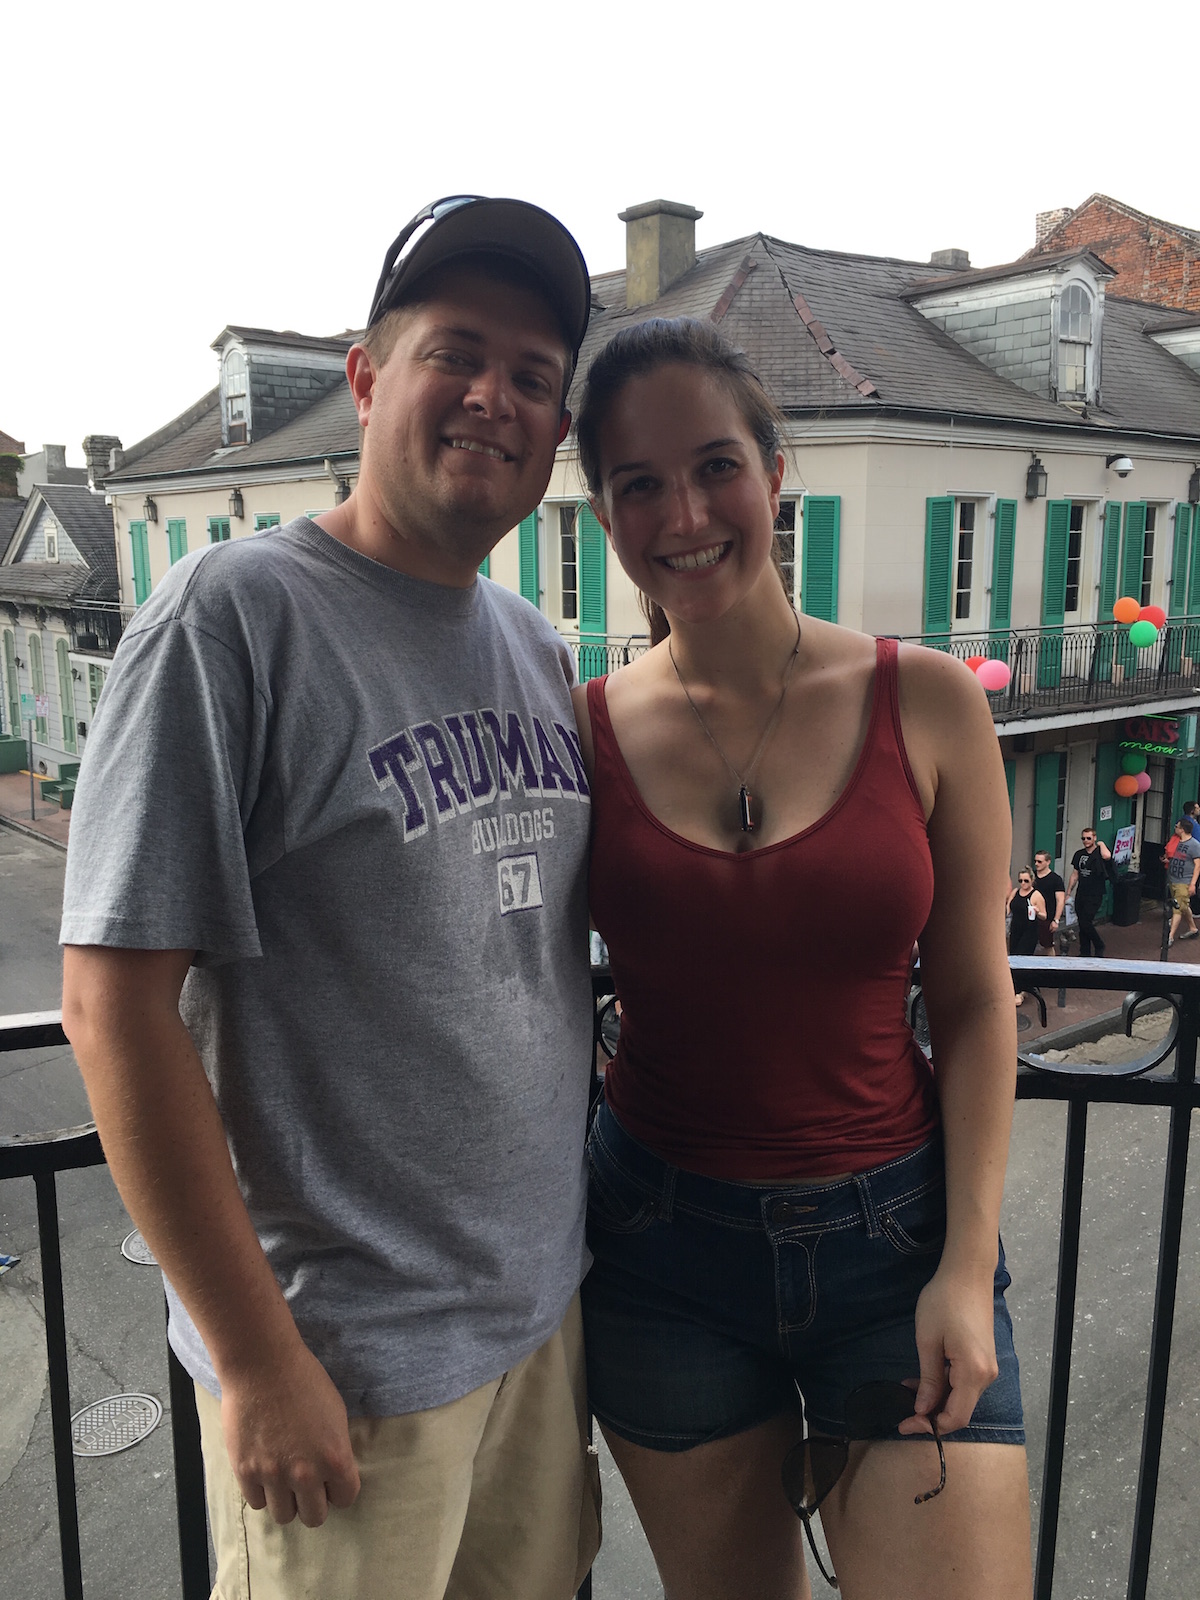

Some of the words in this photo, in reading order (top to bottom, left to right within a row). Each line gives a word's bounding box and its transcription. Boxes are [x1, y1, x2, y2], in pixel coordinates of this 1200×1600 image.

[1115, 839, 1122, 854] 3
[500, 863, 531, 906] 67
[80, 1405, 145, 1446] DRAIN
